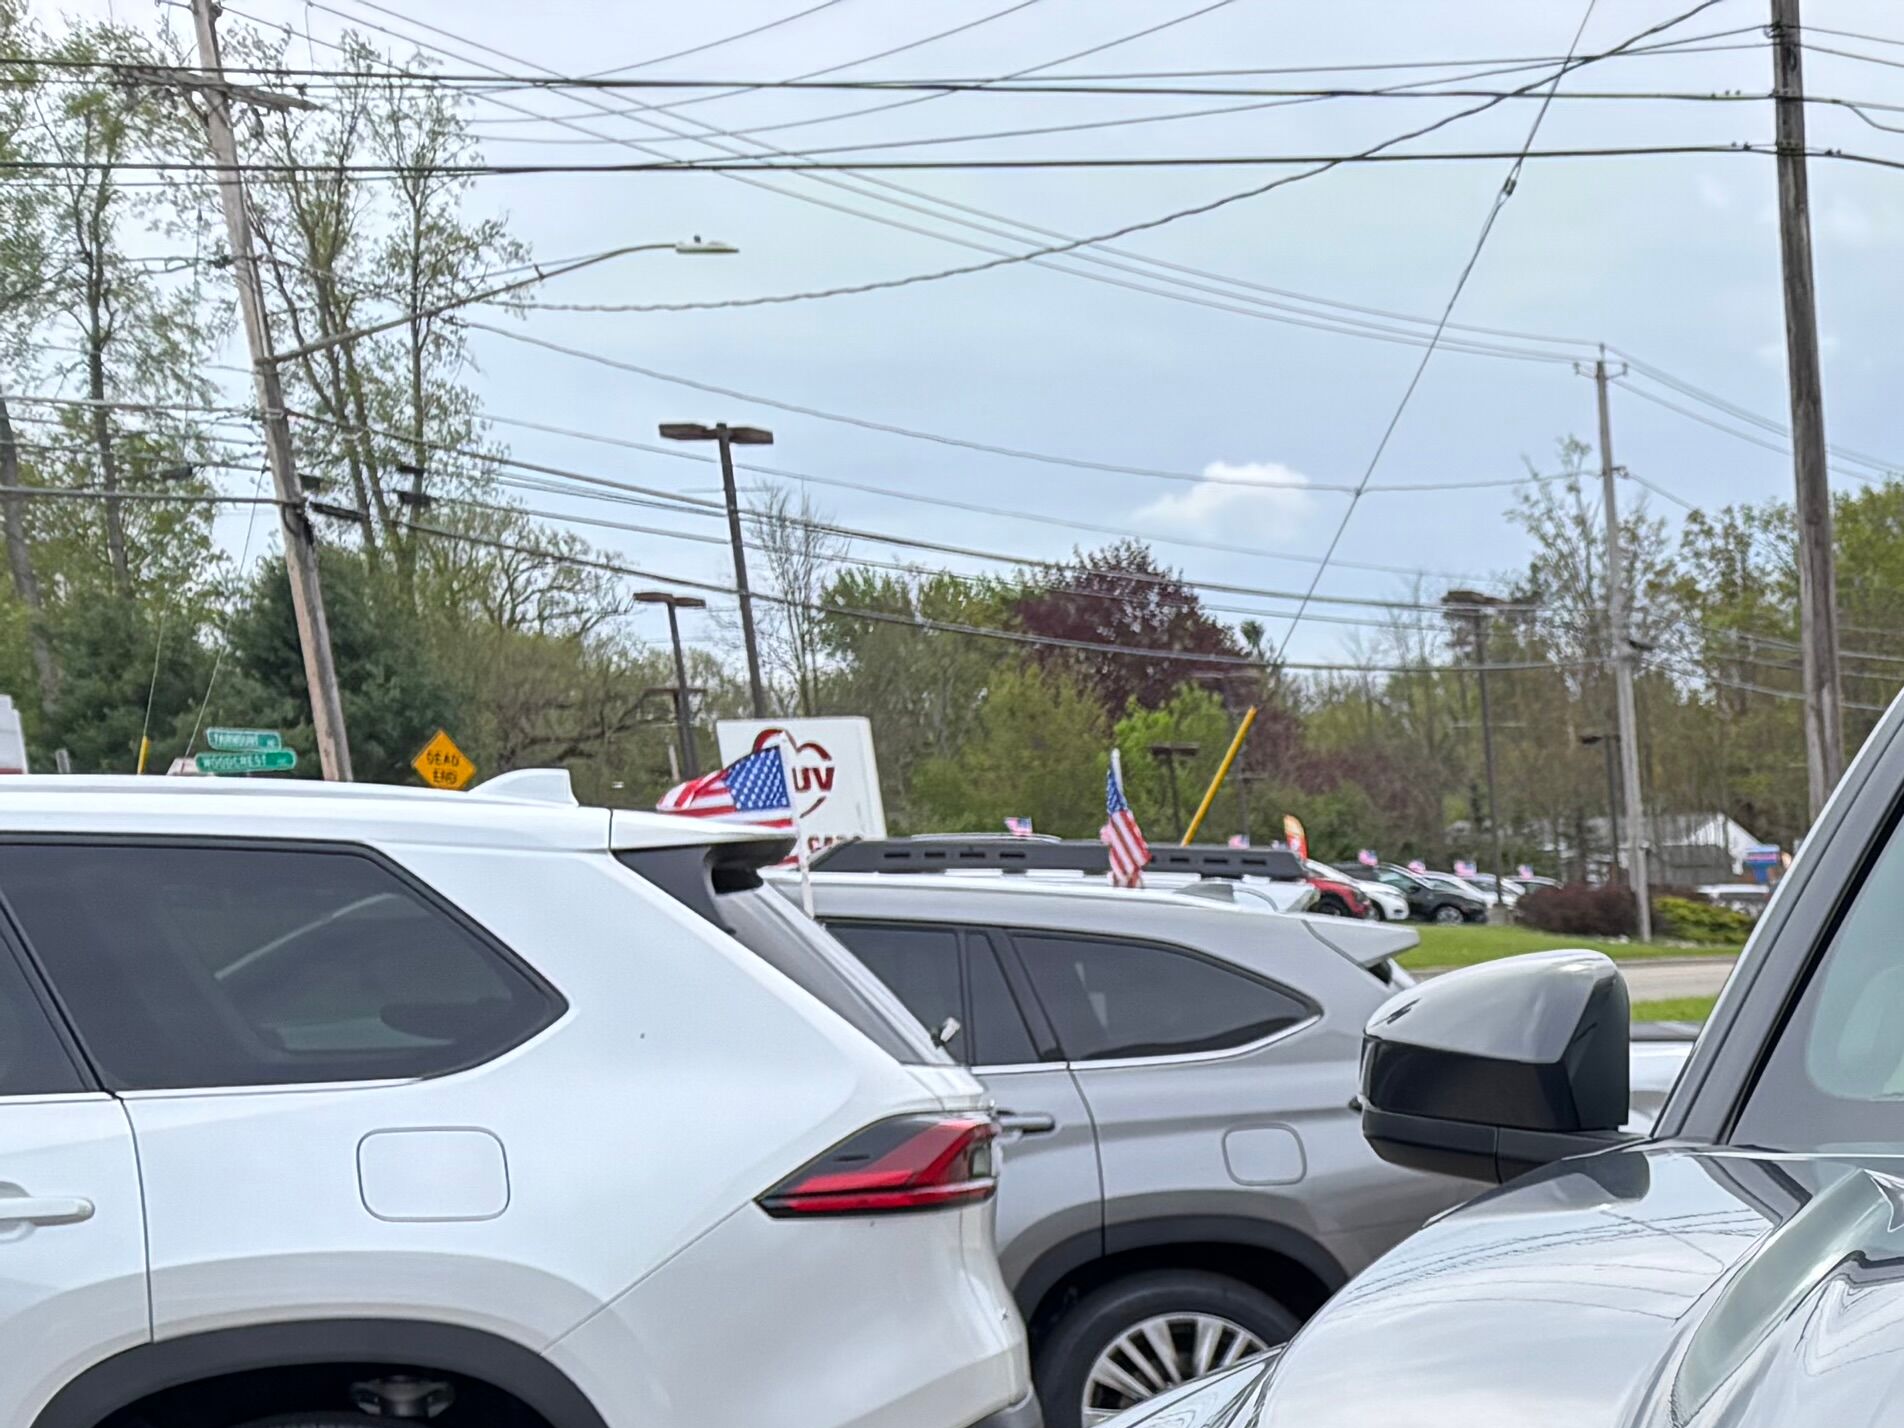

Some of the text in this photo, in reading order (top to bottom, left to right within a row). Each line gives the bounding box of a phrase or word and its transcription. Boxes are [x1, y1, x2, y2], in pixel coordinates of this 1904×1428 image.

[203, 753, 267, 769] WOODCREST
[426, 750, 459, 767] DEAD
[433, 769, 457, 785] END
[792, 767, 835, 792] UV
